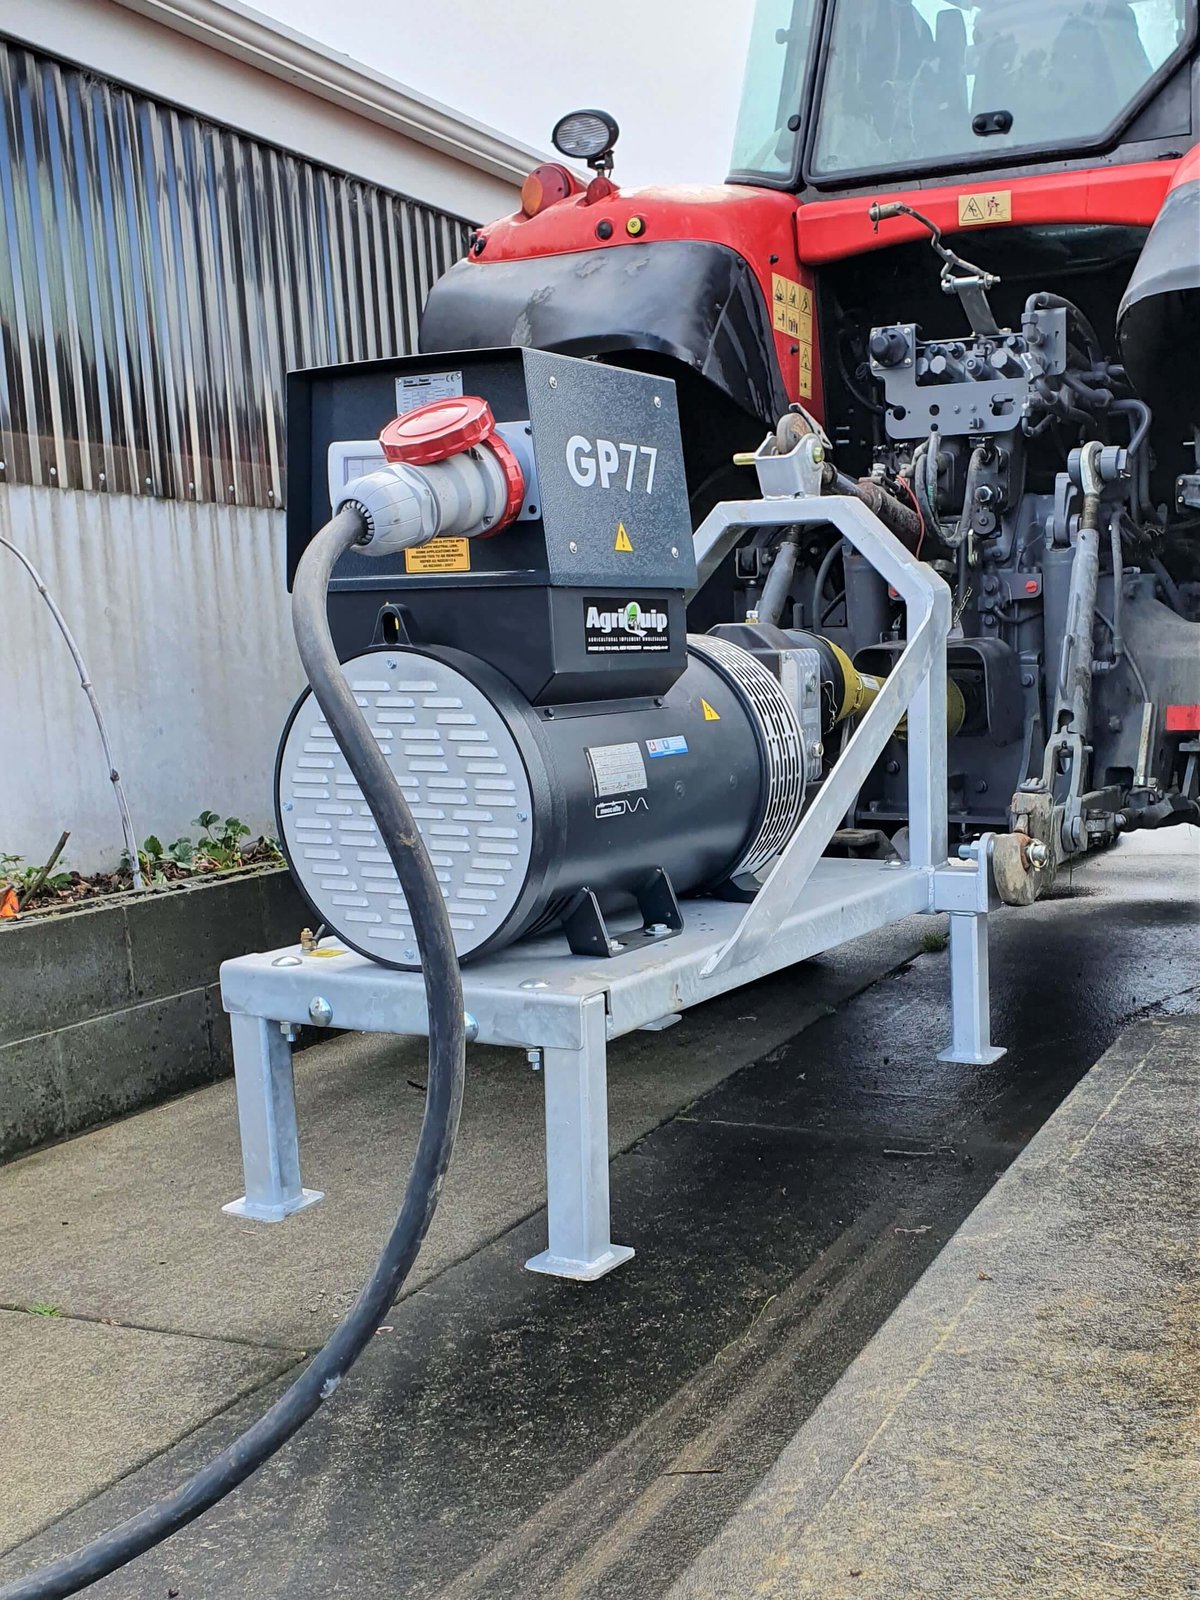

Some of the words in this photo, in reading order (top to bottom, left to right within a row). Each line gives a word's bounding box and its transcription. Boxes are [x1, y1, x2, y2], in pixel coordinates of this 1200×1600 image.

[446, 374, 455, 382] CE
[566, 435, 657, 494] GP77
[586, 602, 668, 637] AgriQuip
